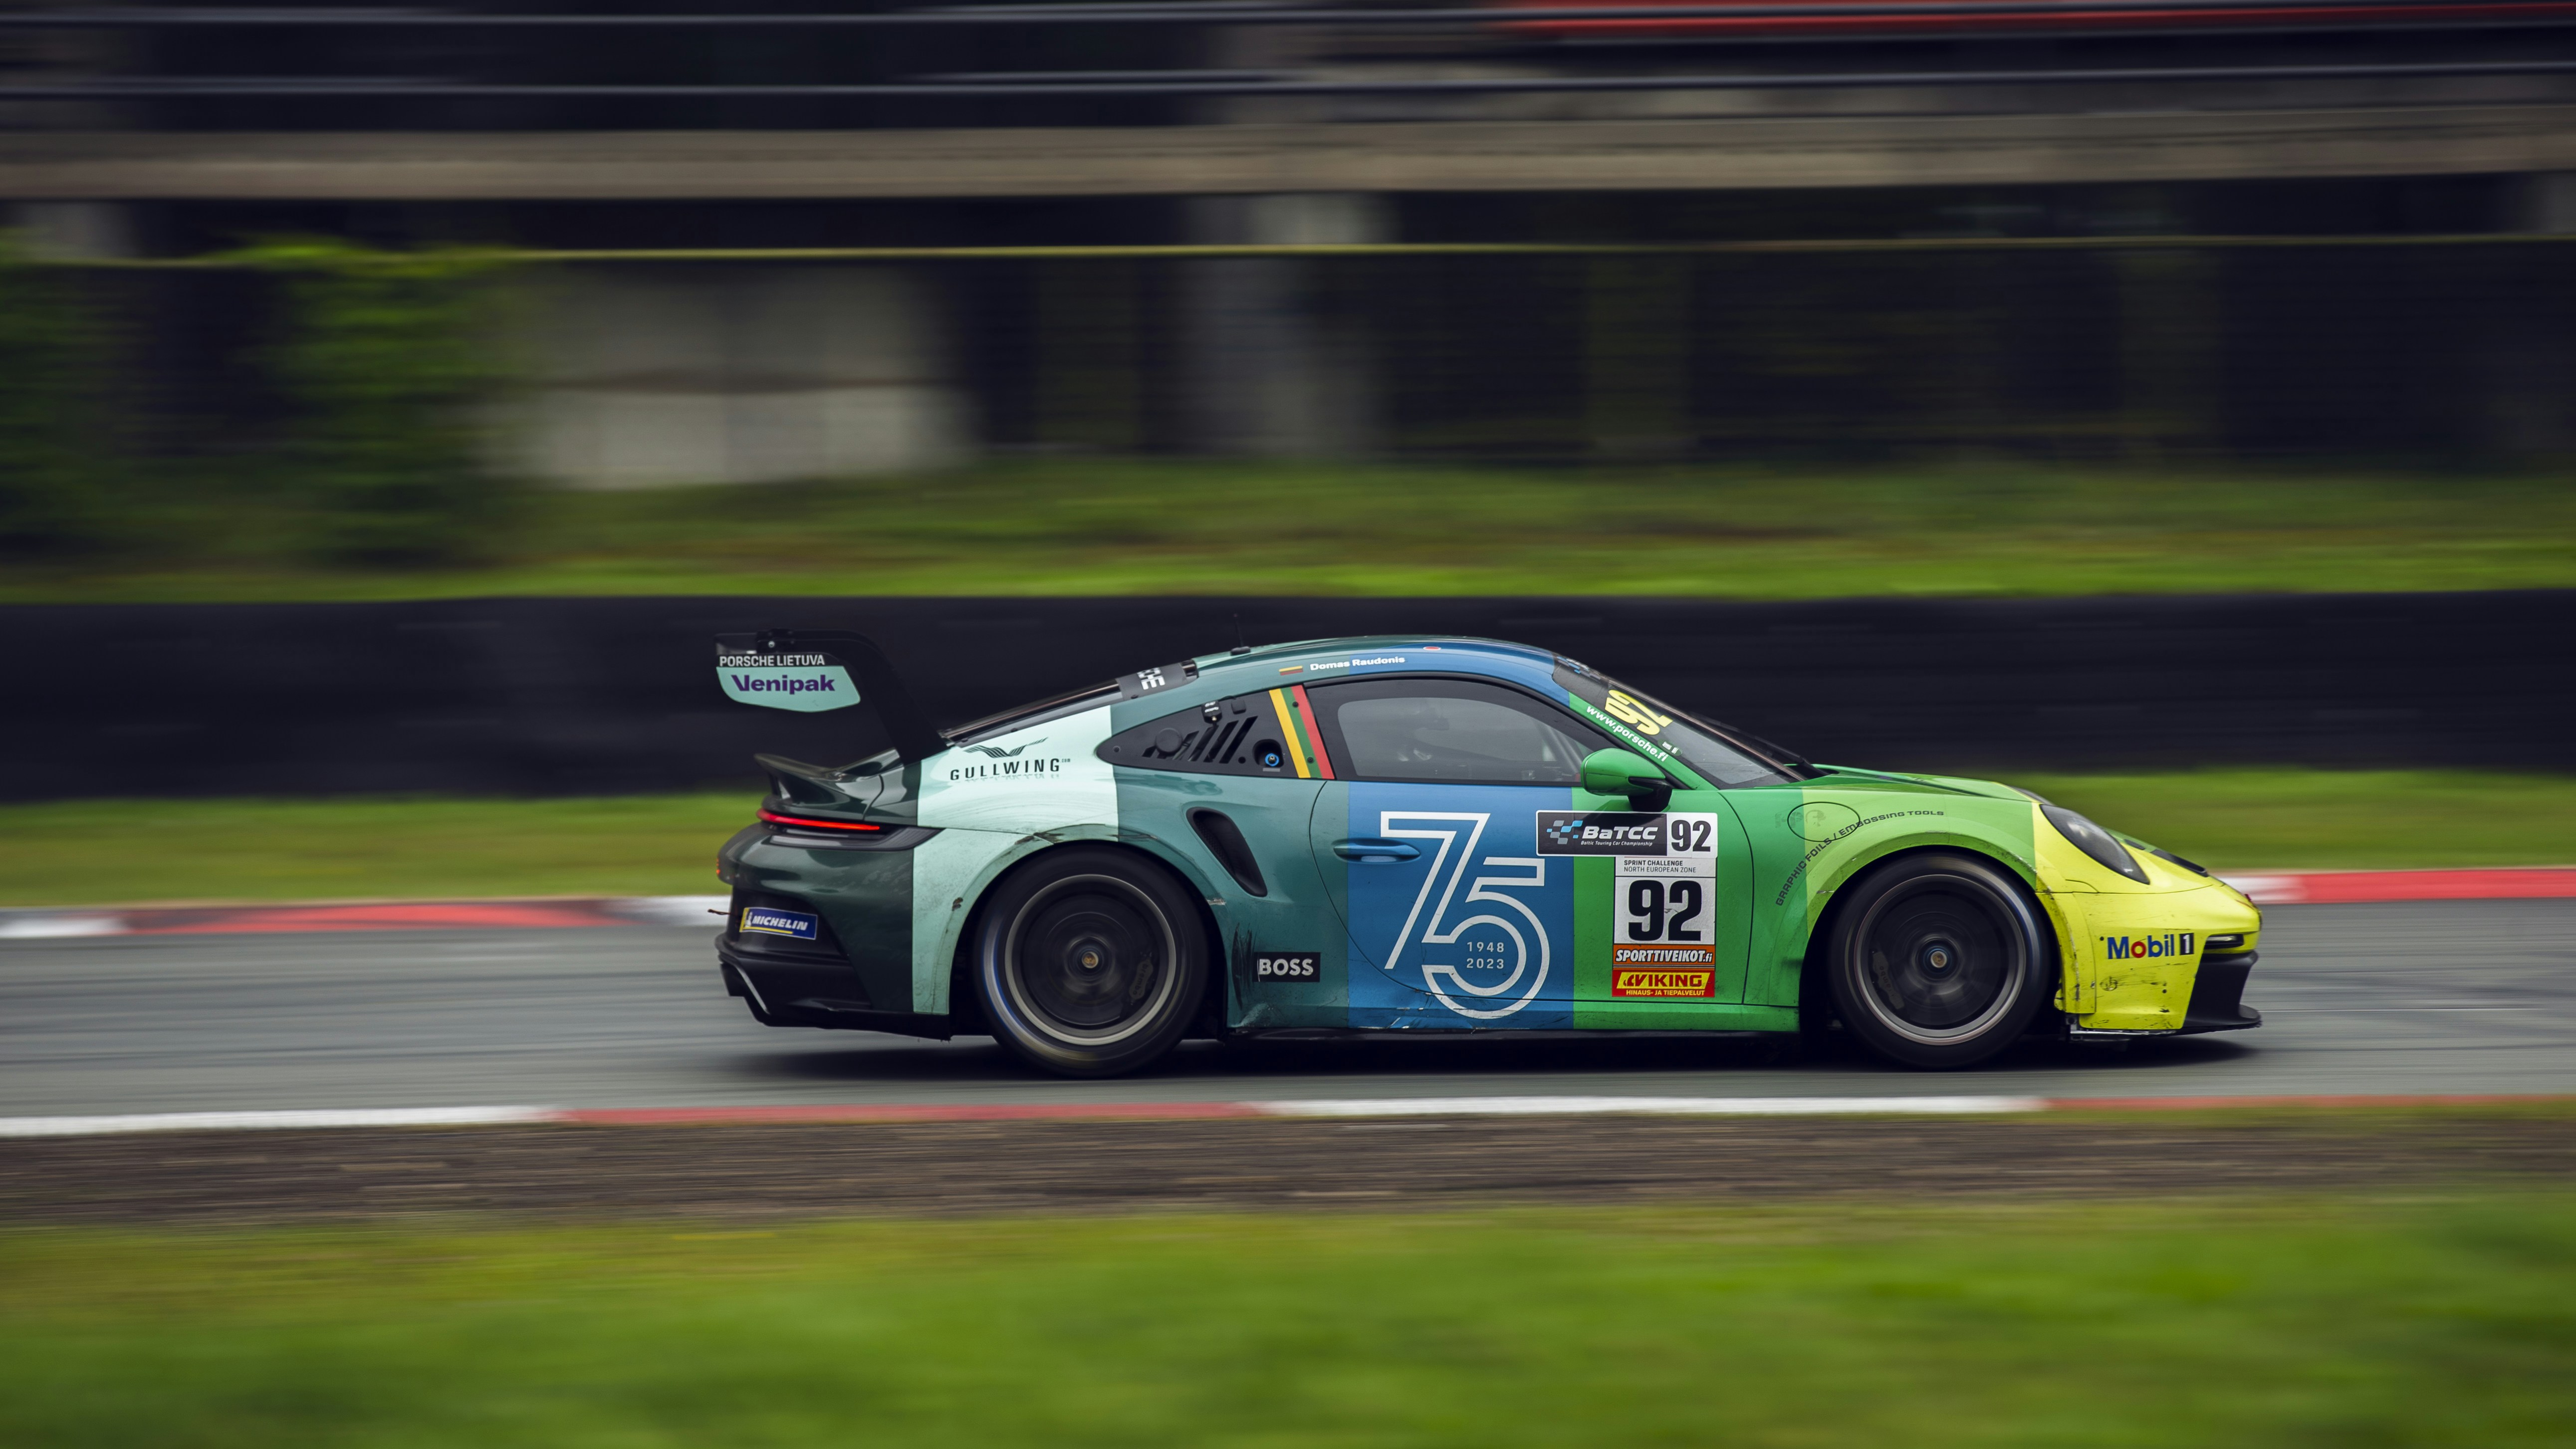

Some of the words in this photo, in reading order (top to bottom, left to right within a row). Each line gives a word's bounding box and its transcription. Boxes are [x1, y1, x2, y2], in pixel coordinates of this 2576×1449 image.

[719, 655, 775, 667] PORSCHE
[776, 655, 825, 666] LIETUVA
[1309, 660, 1350, 671] Domas
[1352, 656, 1406, 667] Raudonis
[730, 674, 835, 695] Venipak
[1586, 706, 1669, 762] www.porsche.fi
[1582, 826, 1658, 840] BaTCC
[1671, 820, 1712, 852] 92
[1775, 860, 1807, 907] GRAPHIC
[1805, 837, 1833, 862] FOILS
[1380, 811, 1550, 1019] 75
[1628, 879, 1702, 942] 92
[751, 915, 809, 931] MICHELIN
[1466, 941, 1505, 954] 1948
[2107, 934, 2175, 960] Mobil
[2181, 933, 2192, 955] 1
[1466, 958, 1505, 970] 2023
[1615, 949, 1713, 963] SPORTTIVEIKOT.fi
[1258, 958, 1314, 976] BOSS
[1635, 974, 1702, 987] VIKING
